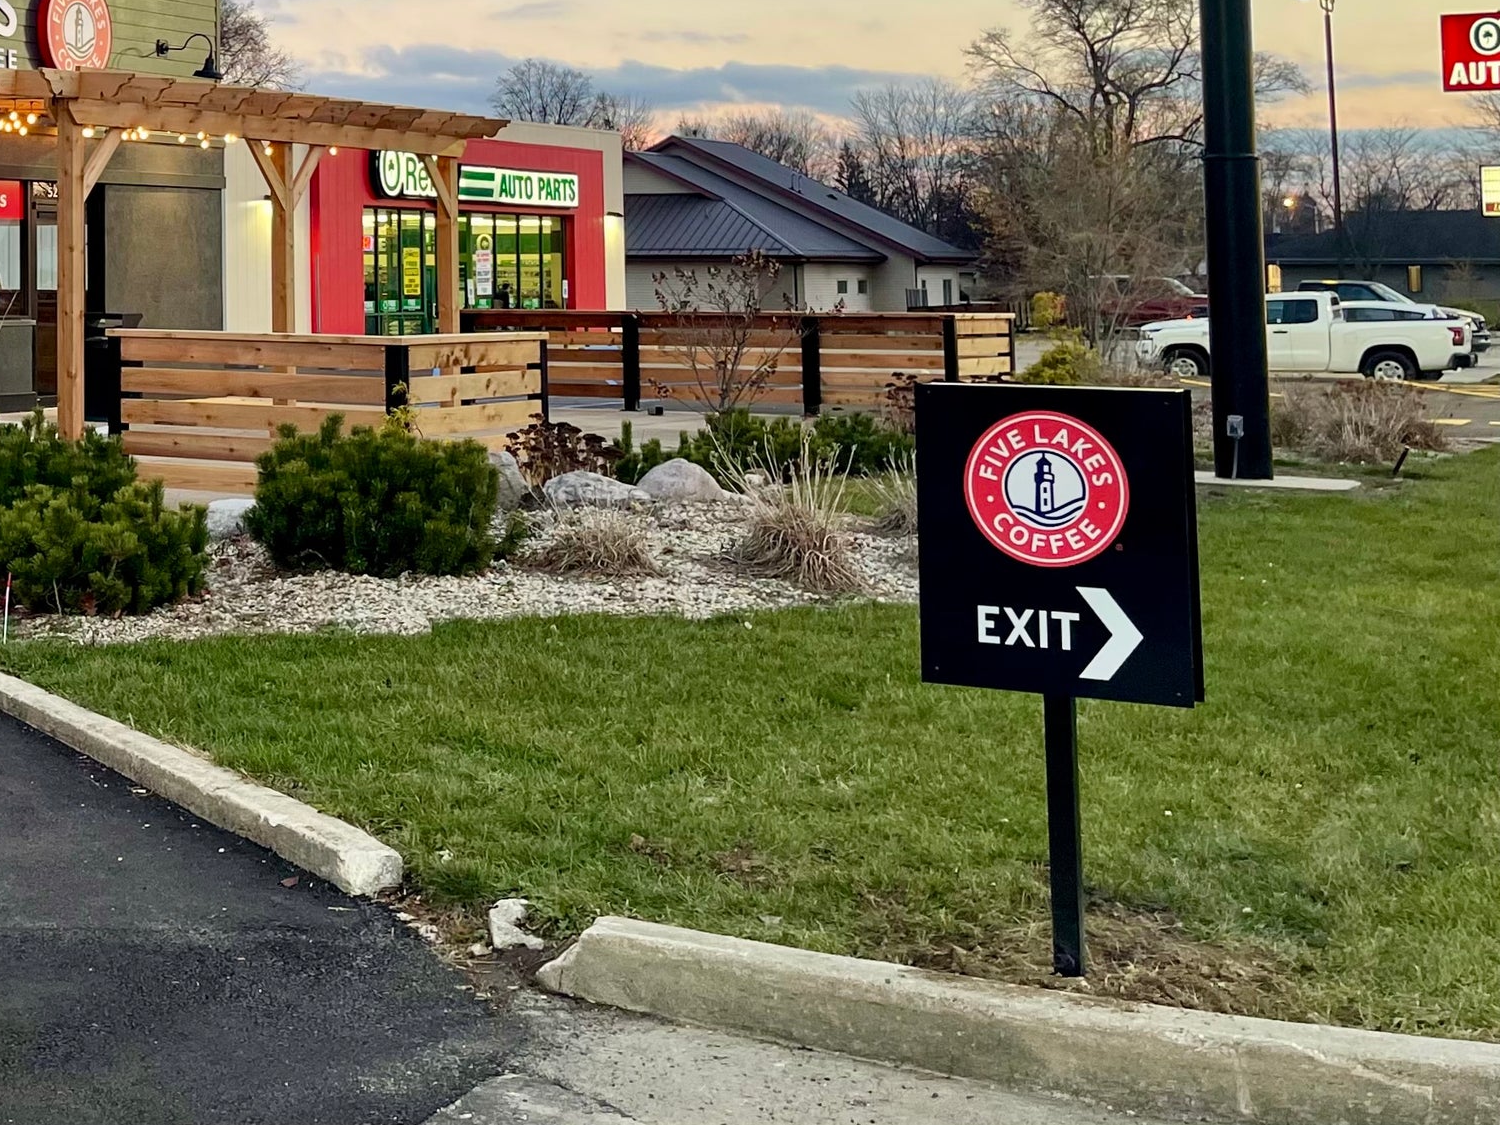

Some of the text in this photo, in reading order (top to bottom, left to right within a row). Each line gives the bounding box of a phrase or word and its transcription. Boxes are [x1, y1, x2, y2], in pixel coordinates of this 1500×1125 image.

[500, 173, 576, 202] AUTO PARTS
[979, 424, 1113, 487] FIVE LAKES
[993, 512, 1102, 555] COFFEE
[977, 605, 1080, 651] EXIT
